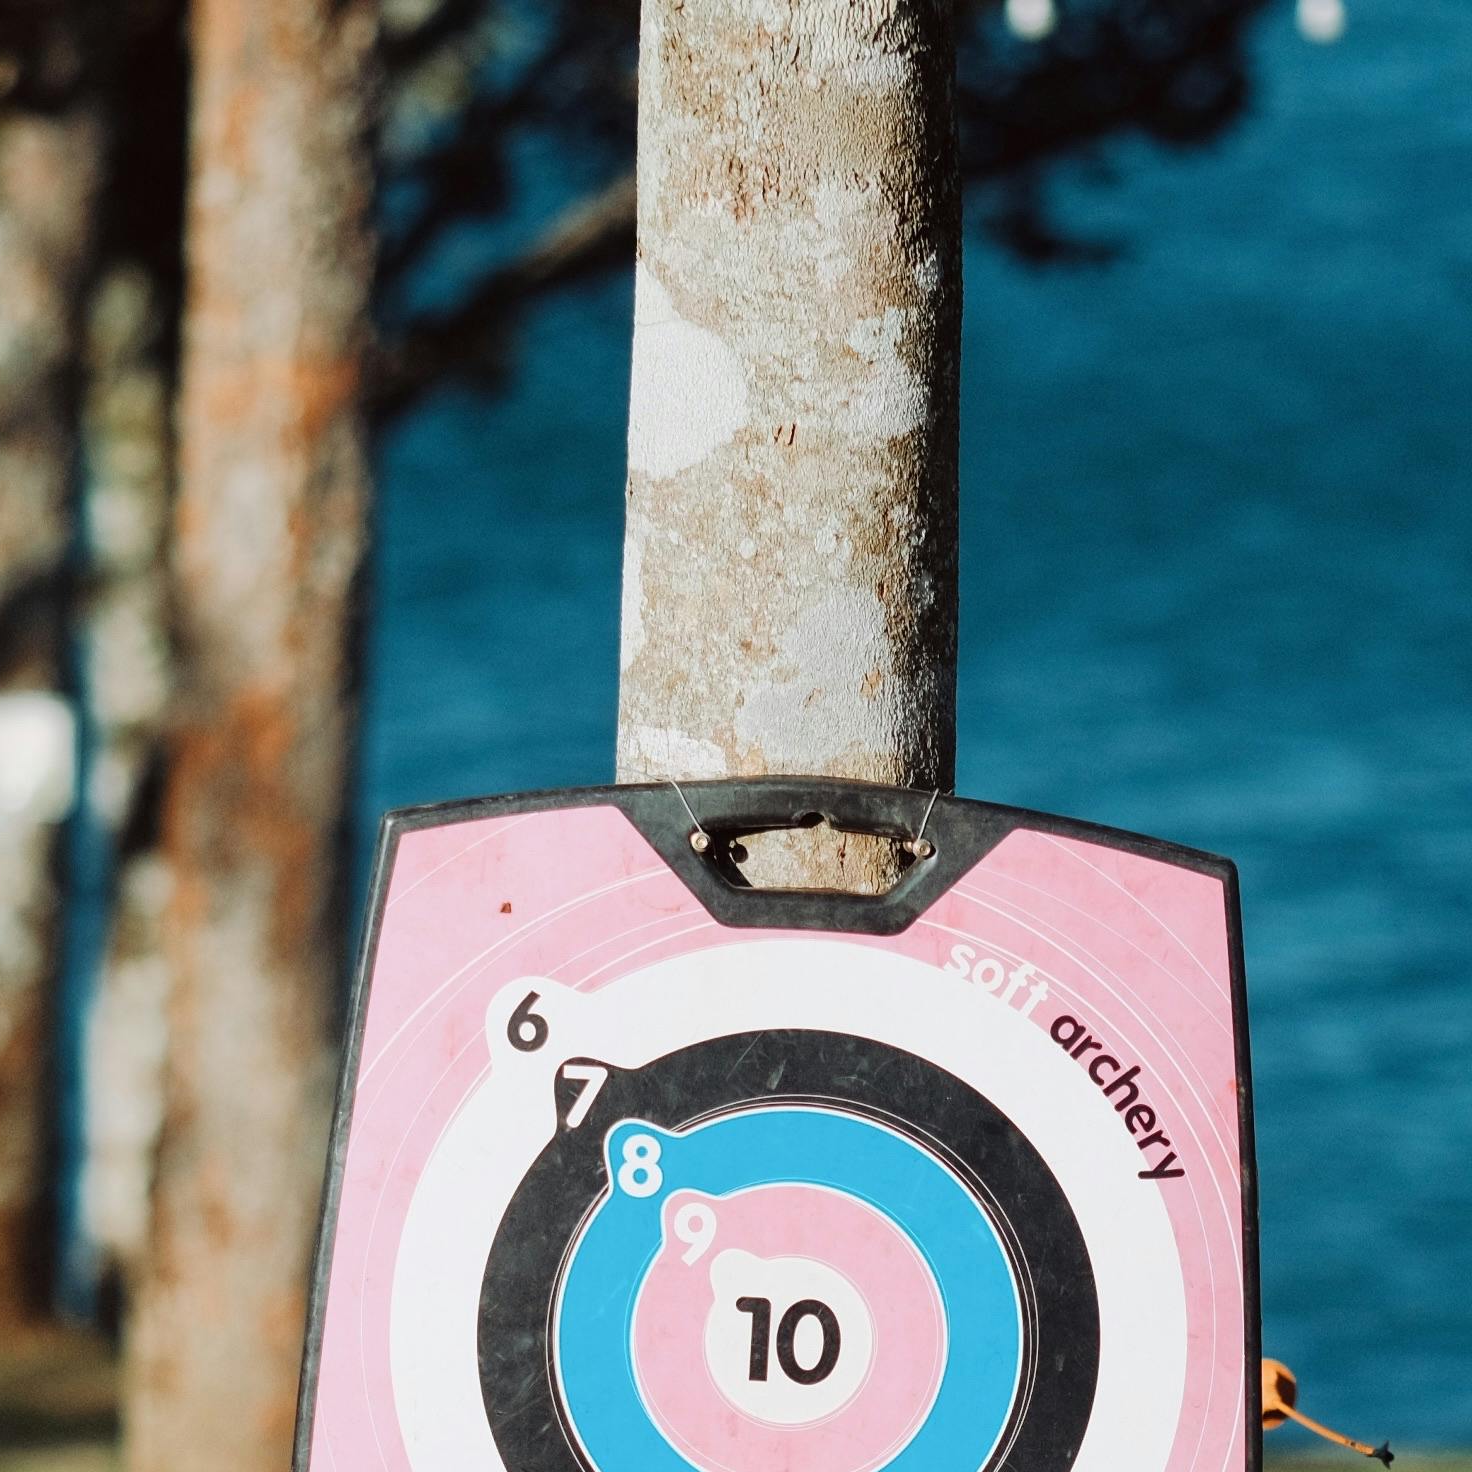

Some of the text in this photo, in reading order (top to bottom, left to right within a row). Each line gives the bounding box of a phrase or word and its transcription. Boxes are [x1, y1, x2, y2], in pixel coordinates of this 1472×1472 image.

[506, 990, 549, 1053] 6
[943, 943, 1186, 1180] soft archery
[562, 1064, 609, 1129] 7
[617, 1133, 664, 1198] 8
[673, 1202, 718, 1267] 9
[735, 1296, 842, 1386] 10
